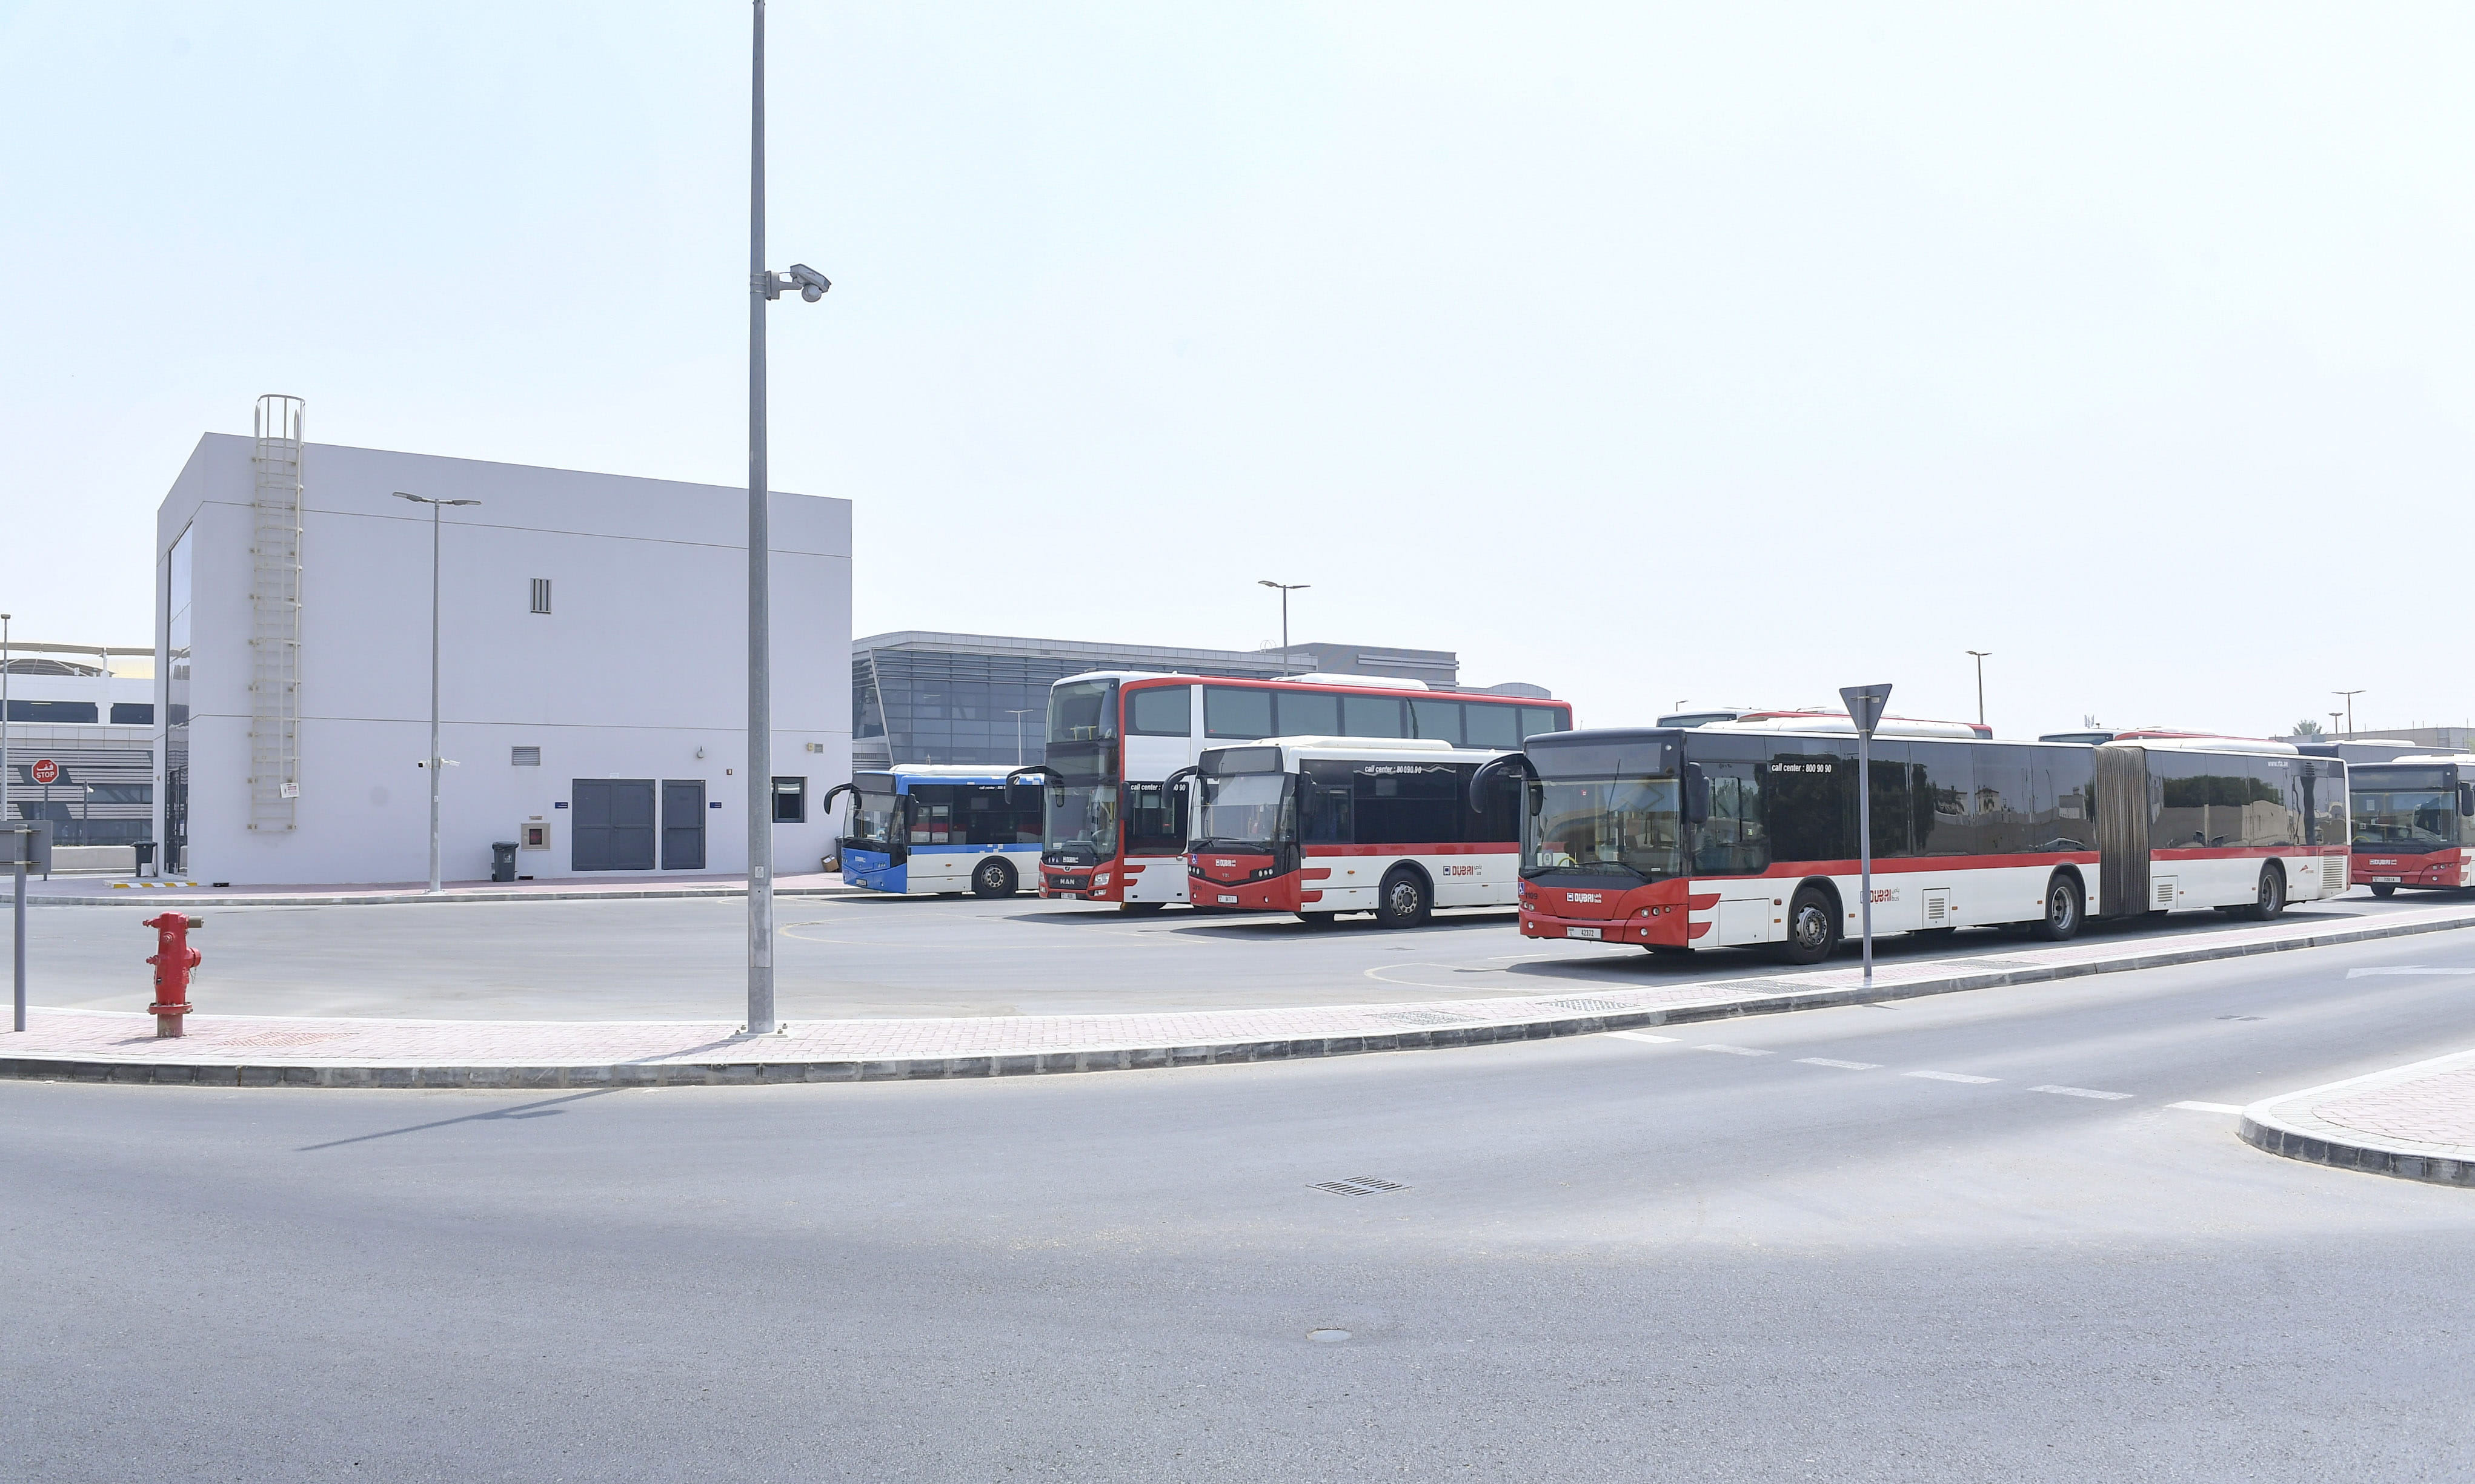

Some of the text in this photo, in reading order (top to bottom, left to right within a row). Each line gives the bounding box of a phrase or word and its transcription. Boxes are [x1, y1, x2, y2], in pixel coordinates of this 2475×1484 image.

[1772, 763, 1782, 772] call
[1783, 763, 1801, 772] center
[1806, 764, 1816, 773] 800
[1816, 764, 1824, 773] 90
[1824, 764, 1832, 773] 90
[1452, 866, 1473, 876] DUBAI
[1574, 892, 1594, 903] DUBAI
